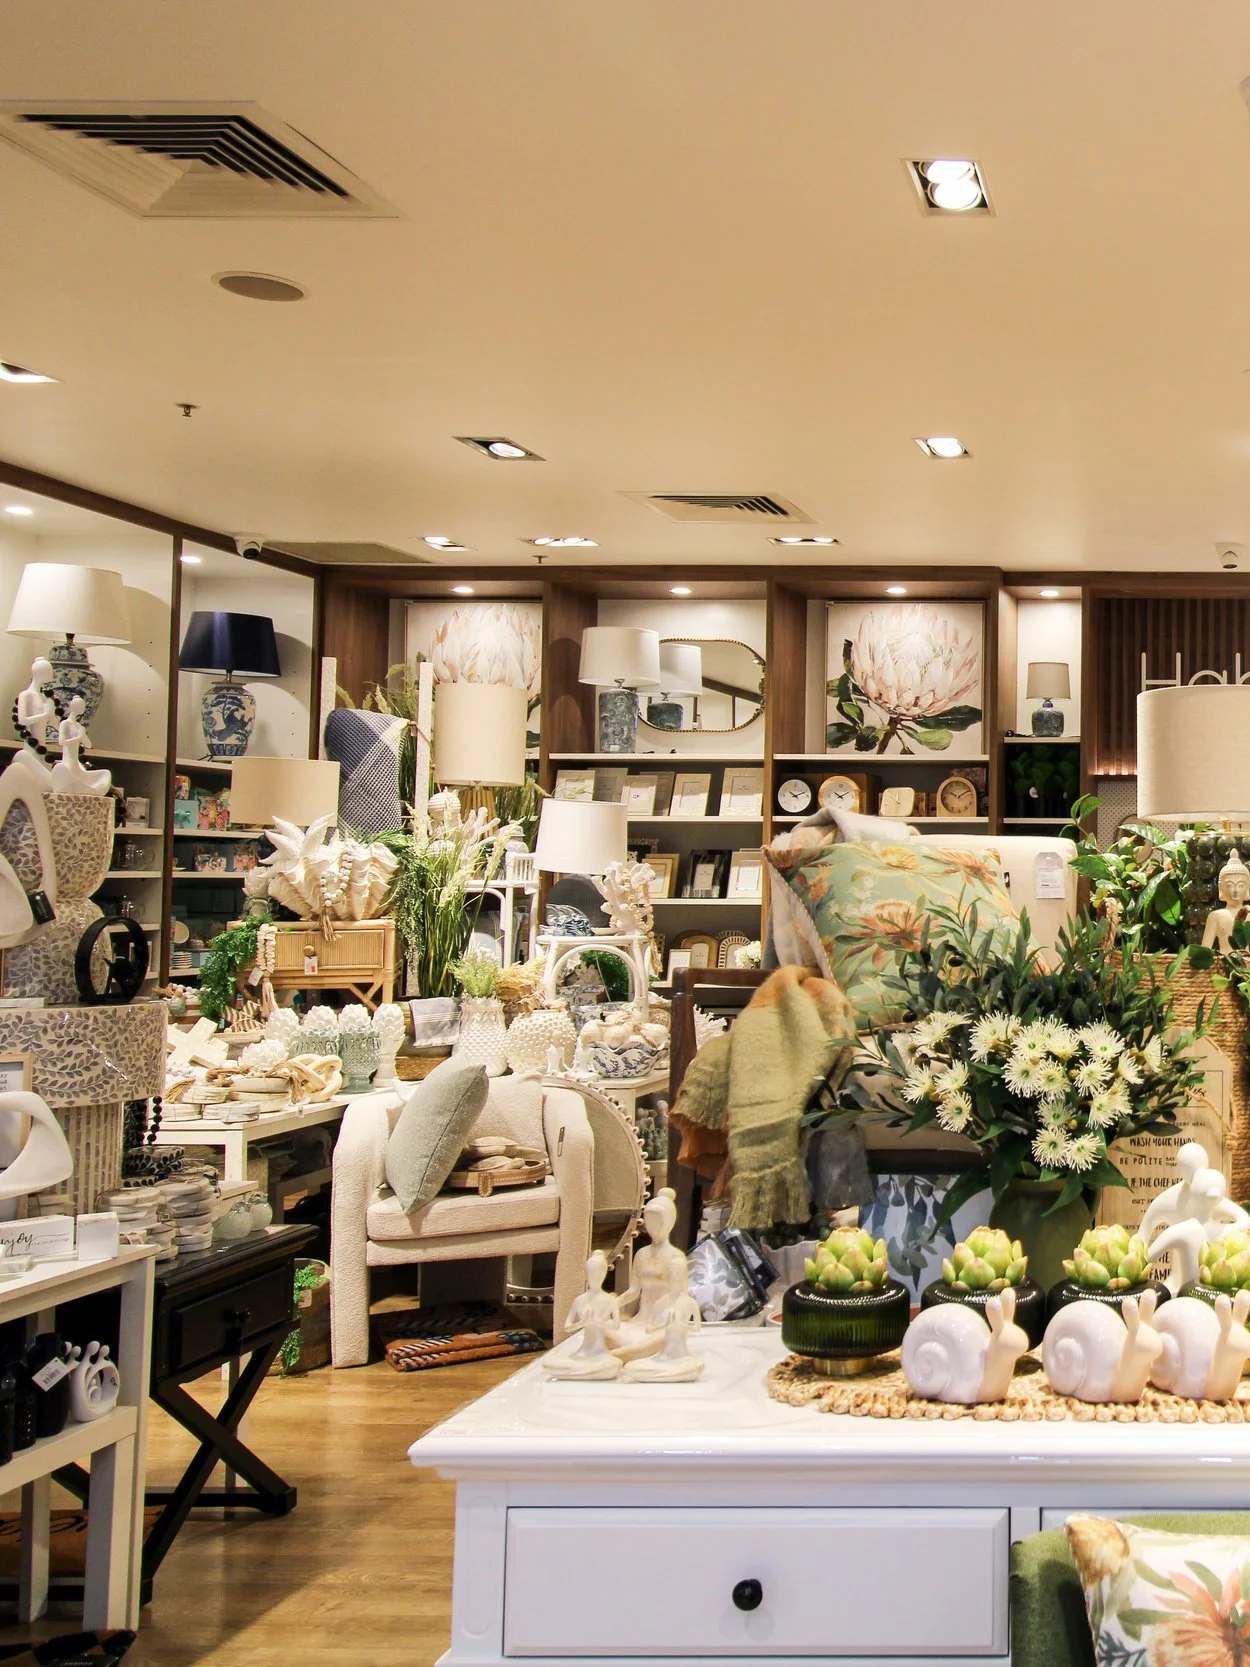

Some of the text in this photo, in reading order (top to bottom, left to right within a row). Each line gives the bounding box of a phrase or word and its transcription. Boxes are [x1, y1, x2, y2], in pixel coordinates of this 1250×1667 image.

[1130, 1137, 1151, 1147] WASH
[1153, 1137, 1172, 1147] YOUR
[1119, 1157, 1129, 1165] BE
[1133, 1157, 1163, 1166] POLITE
[1139, 1177, 1153, 1188] THE
[1153, 1177, 1169, 1188] CHEF
